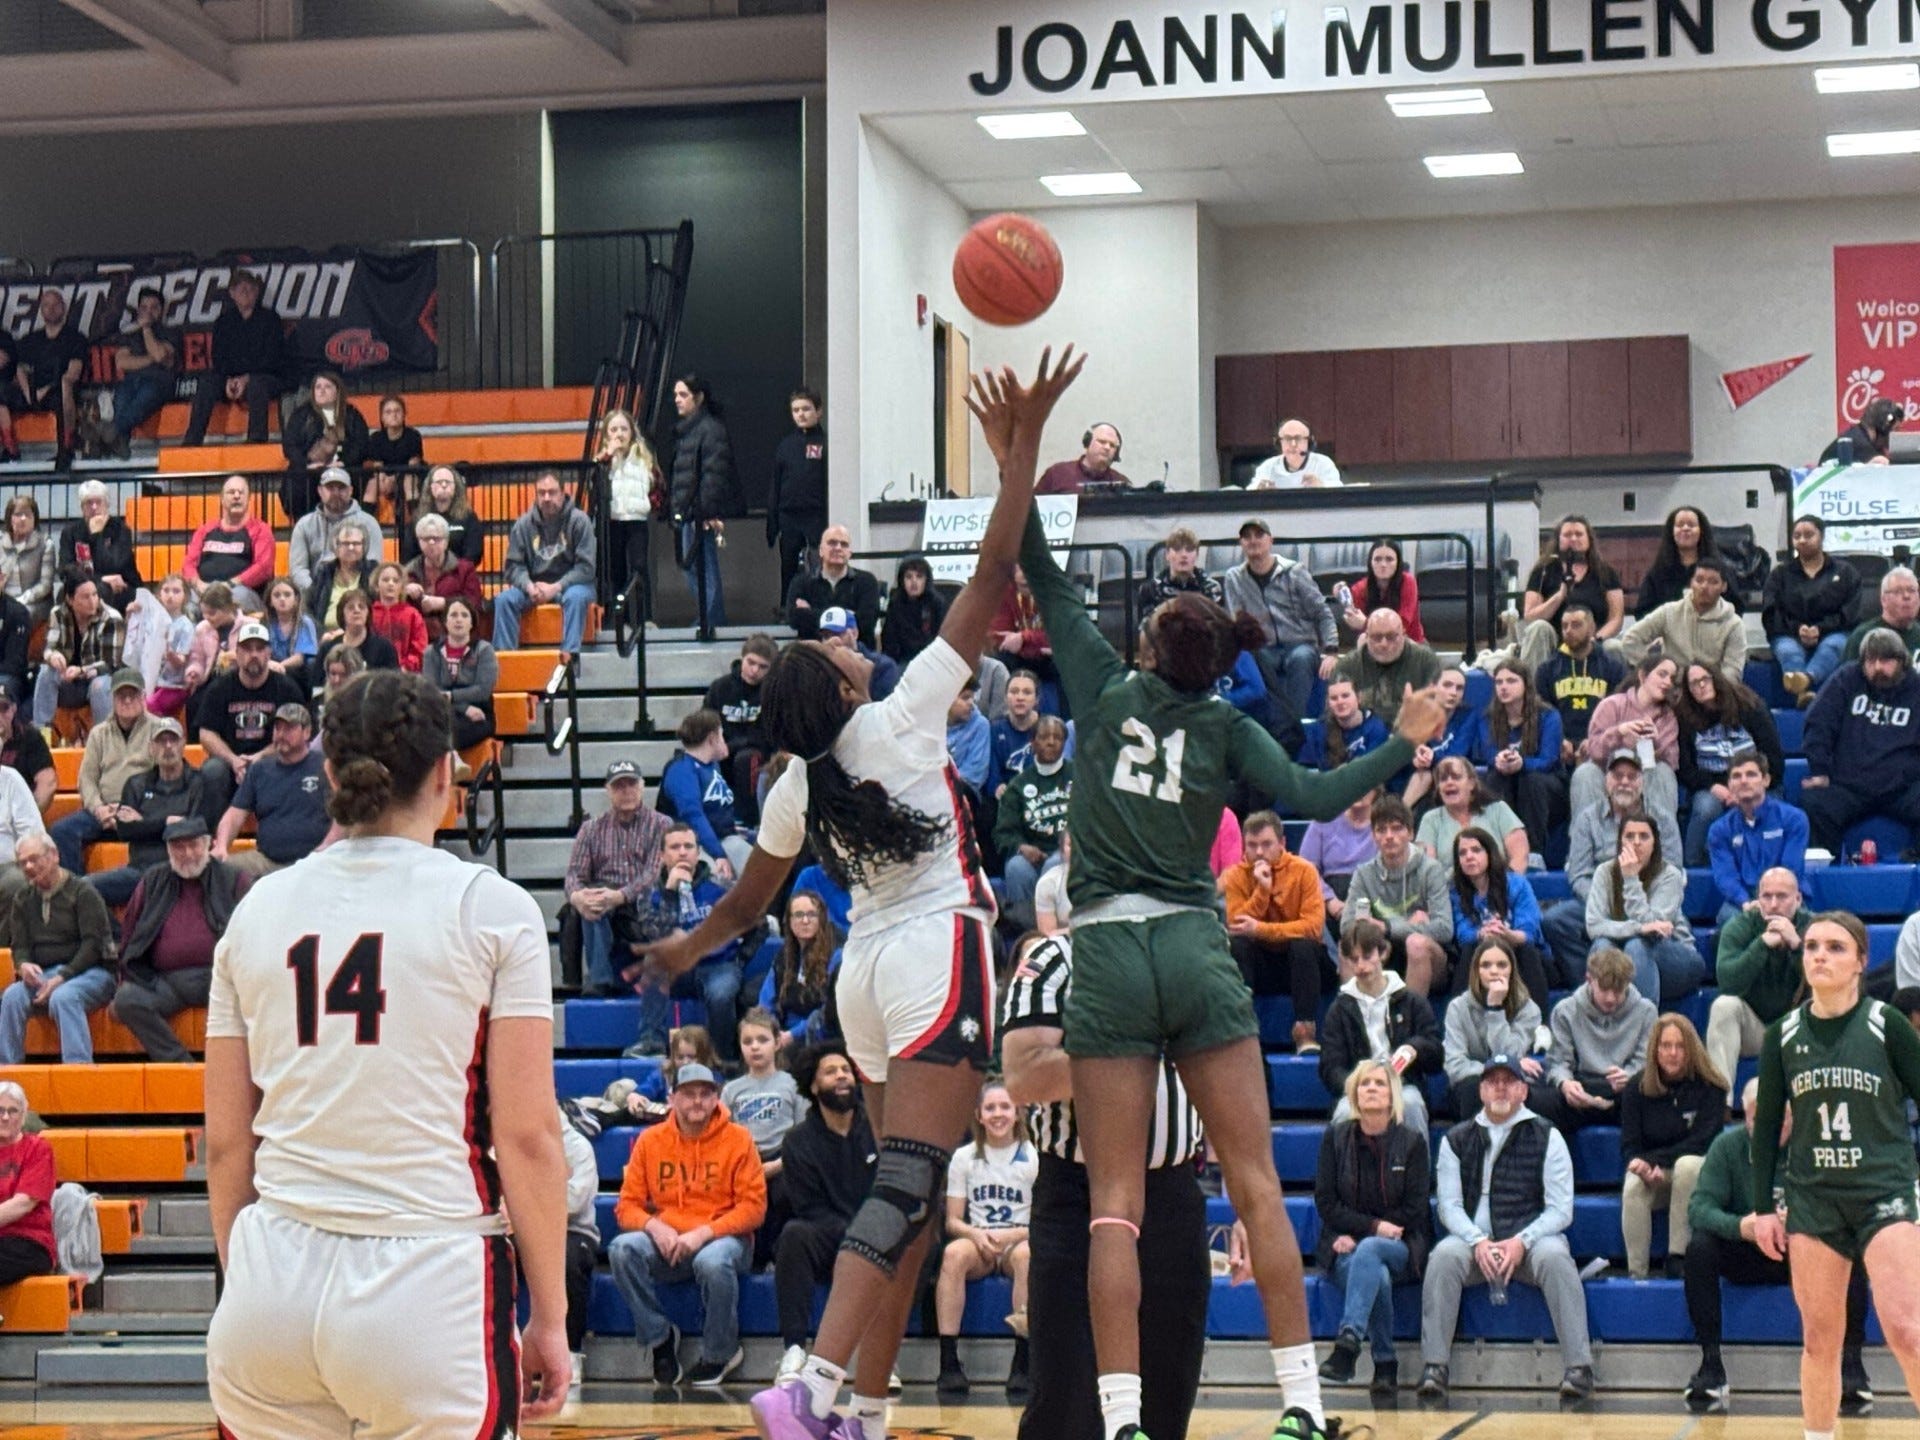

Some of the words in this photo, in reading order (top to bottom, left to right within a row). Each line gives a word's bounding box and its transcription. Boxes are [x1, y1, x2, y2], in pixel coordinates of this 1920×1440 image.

[969, 8, 1287, 96] JOANN
[1324, 0, 1715, 77] MULLEN
[1862, 321, 1918, 349] VIP
[1820, 490, 1848, 500] THE
[1821, 499, 1900, 516] PULSE
[1111, 716, 1187, 804] 21
[286, 931, 387, 1048] 14
[1817, 1102, 1852, 1142] 14
[1813, 1147, 1863, 1169] PREP
[973, 1184, 1024, 1204] SENECA
